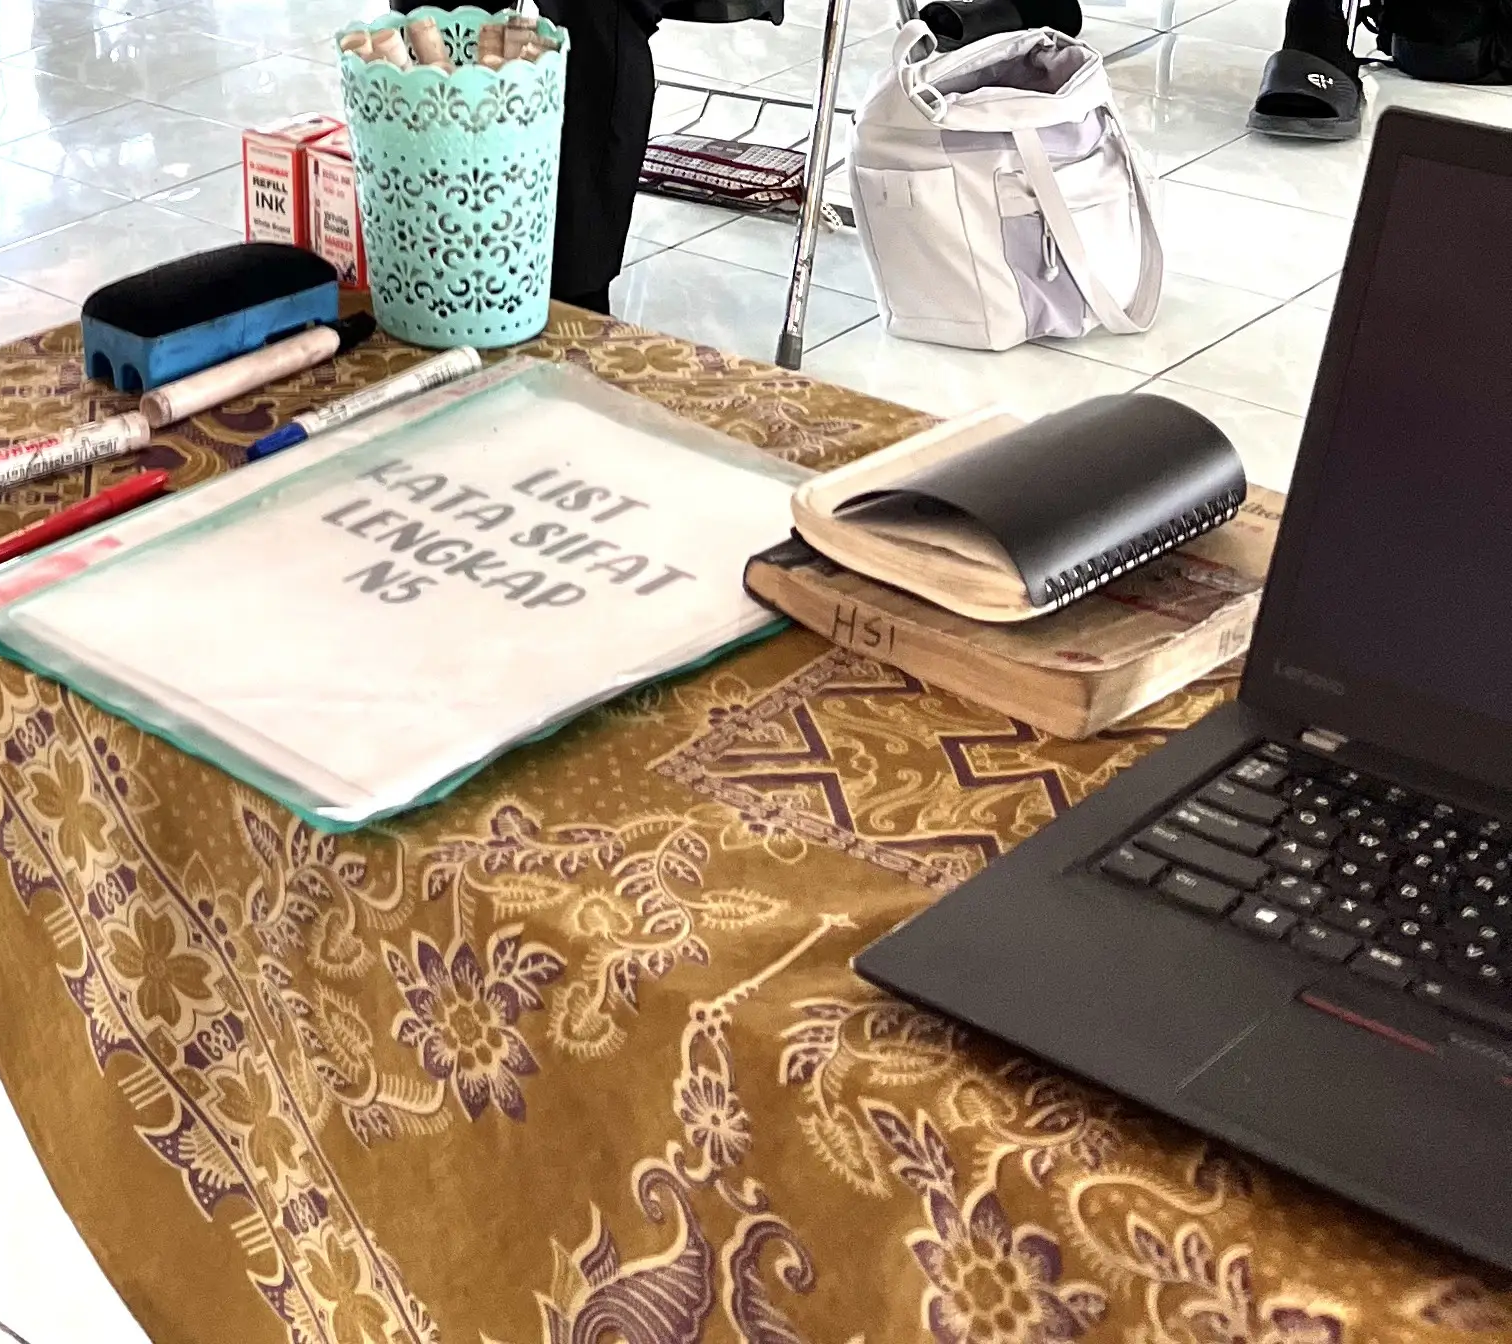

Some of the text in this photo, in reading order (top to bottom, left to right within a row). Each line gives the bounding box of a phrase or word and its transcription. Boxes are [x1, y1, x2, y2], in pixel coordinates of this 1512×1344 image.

[252, 175, 288, 195] REFILL
[255, 190, 286, 215] INK
[512, 465, 651, 524] LIST
[356, 459, 698, 596] KATA SIFAT
[320, 498, 587, 610] LENGKAP
[342, 560, 439, 605] N5
[831, 602, 896, 651] HSI
